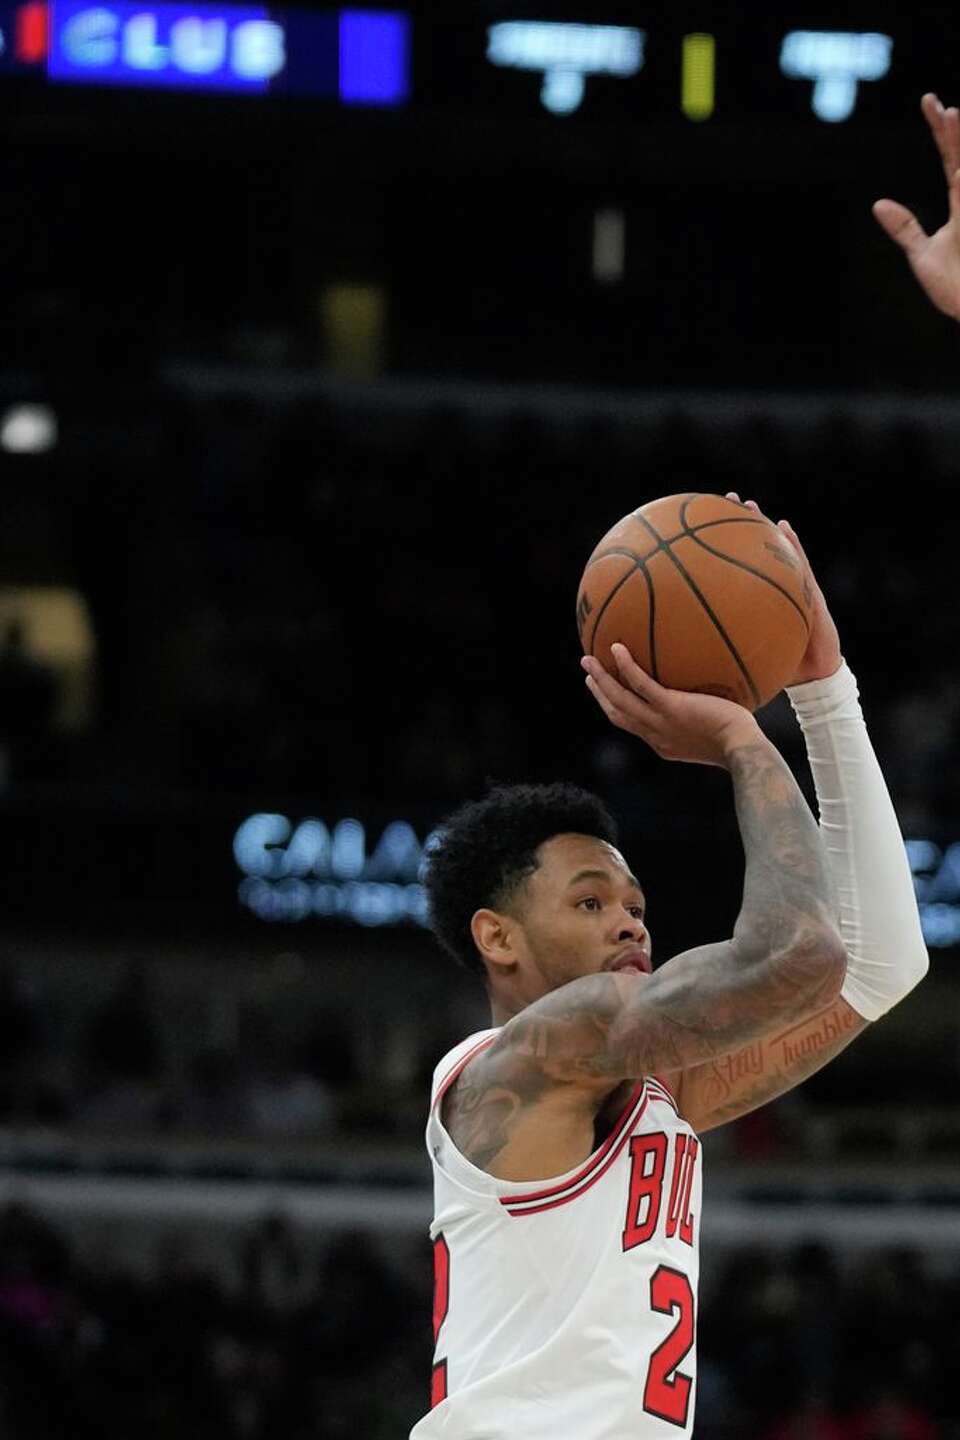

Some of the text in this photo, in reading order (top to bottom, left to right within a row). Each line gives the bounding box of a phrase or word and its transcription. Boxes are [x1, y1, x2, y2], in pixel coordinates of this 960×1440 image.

[234, 812, 432, 879] CALA
[704, 1010, 856, 1106] Stay humble
